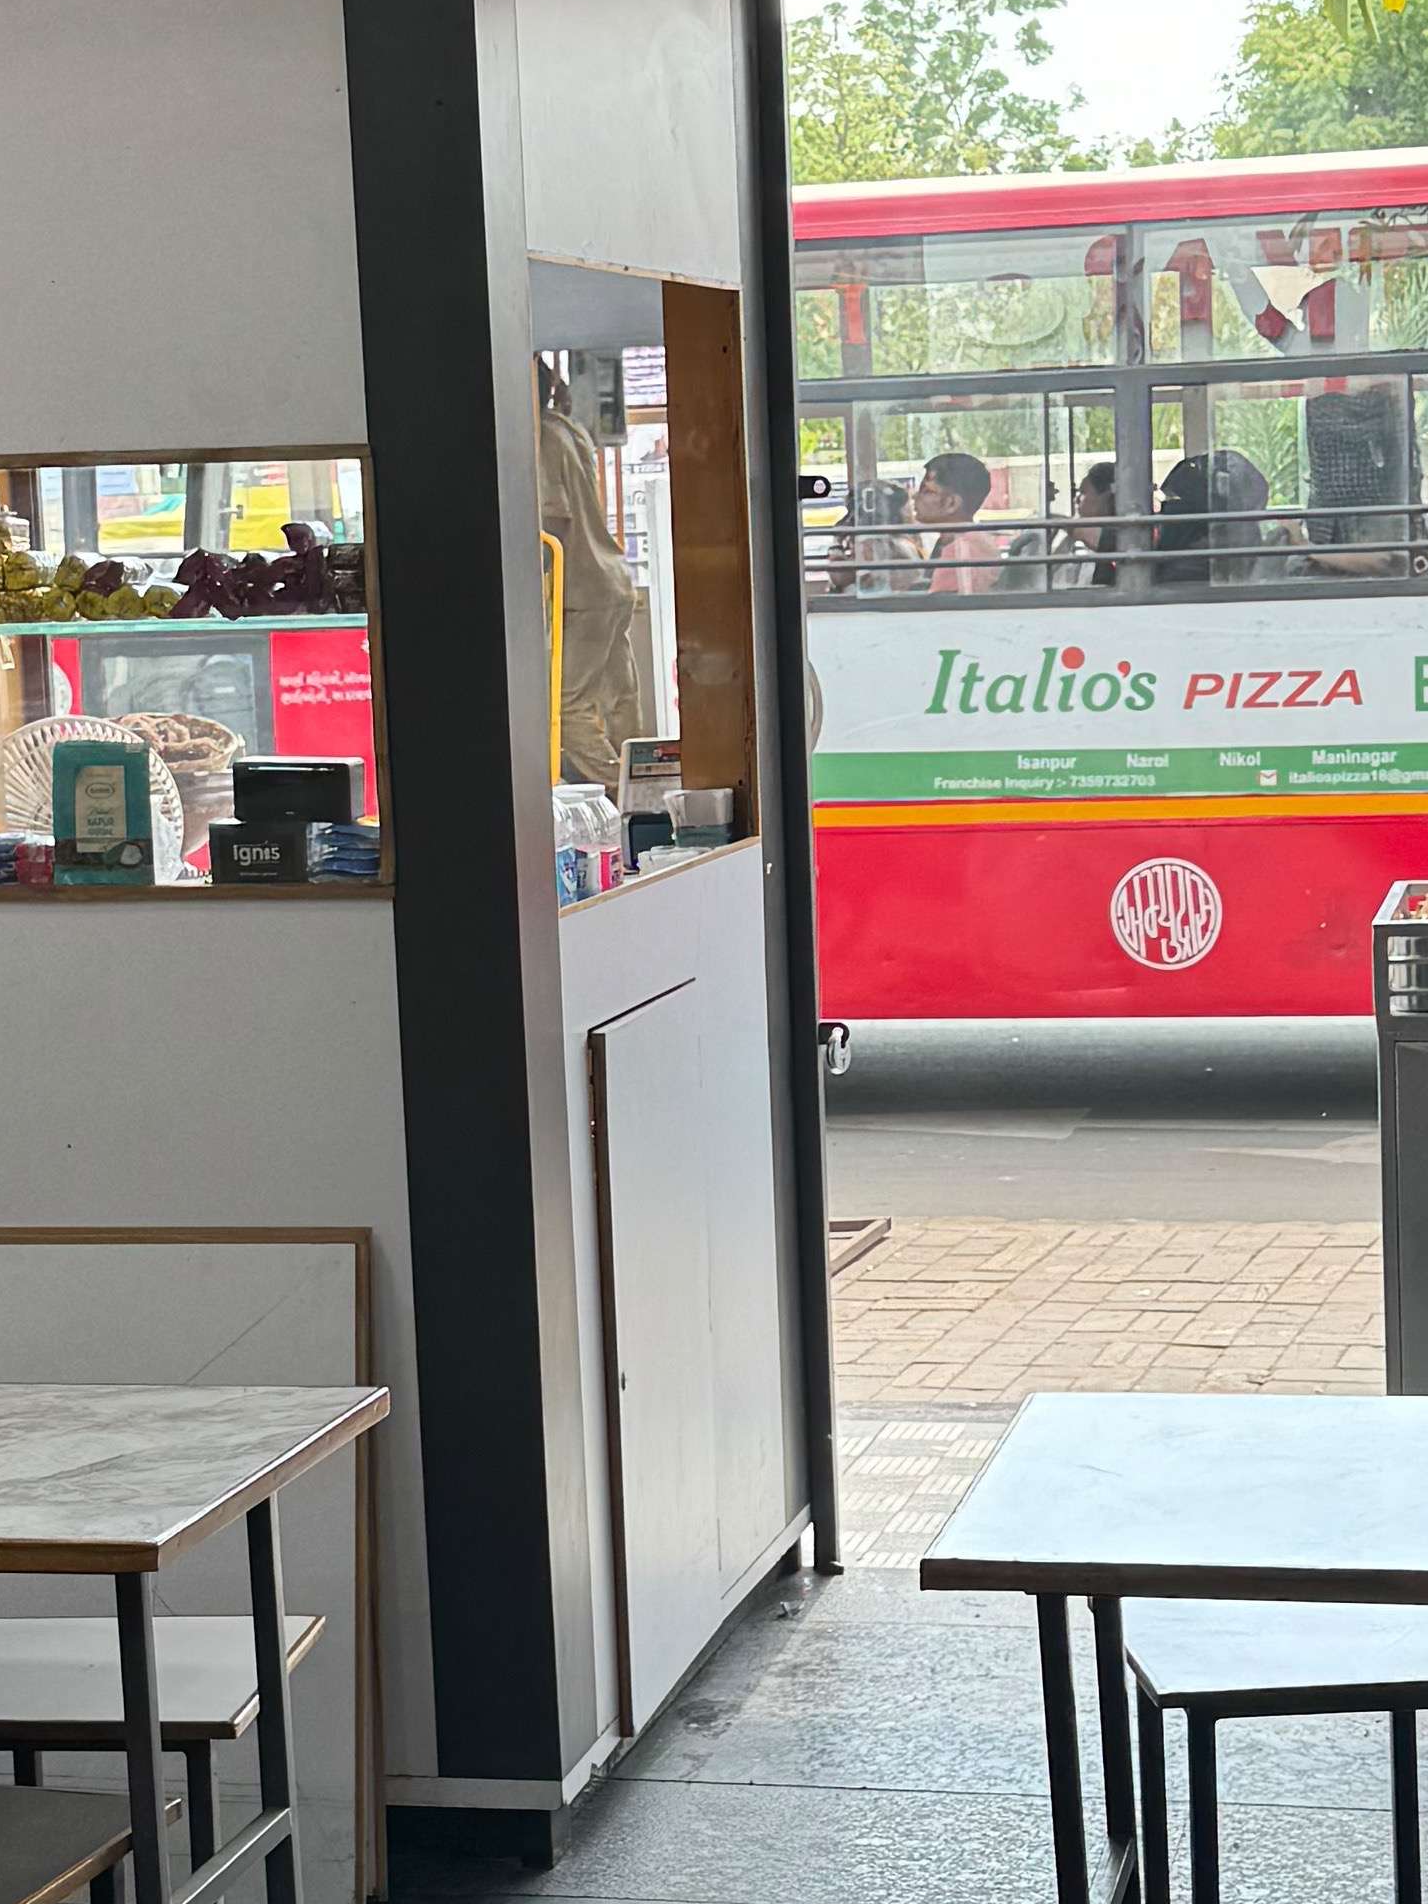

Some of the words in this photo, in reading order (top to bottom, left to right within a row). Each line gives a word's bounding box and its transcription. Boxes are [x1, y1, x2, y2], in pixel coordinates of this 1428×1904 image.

[924, 646, 1157, 715] Italio's
[1183, 669, 1364, 710] PIZZA
[1017, 753, 1077, 772] Isanpur
[1126, 752, 1170, 769] Narol
[1219, 750, 1262, 767] Nikol
[1311, 748, 1398, 766] Maninagar
[933, 776, 1002, 790] Franchise
[1004, 775, 1055, 792] Inquiry
